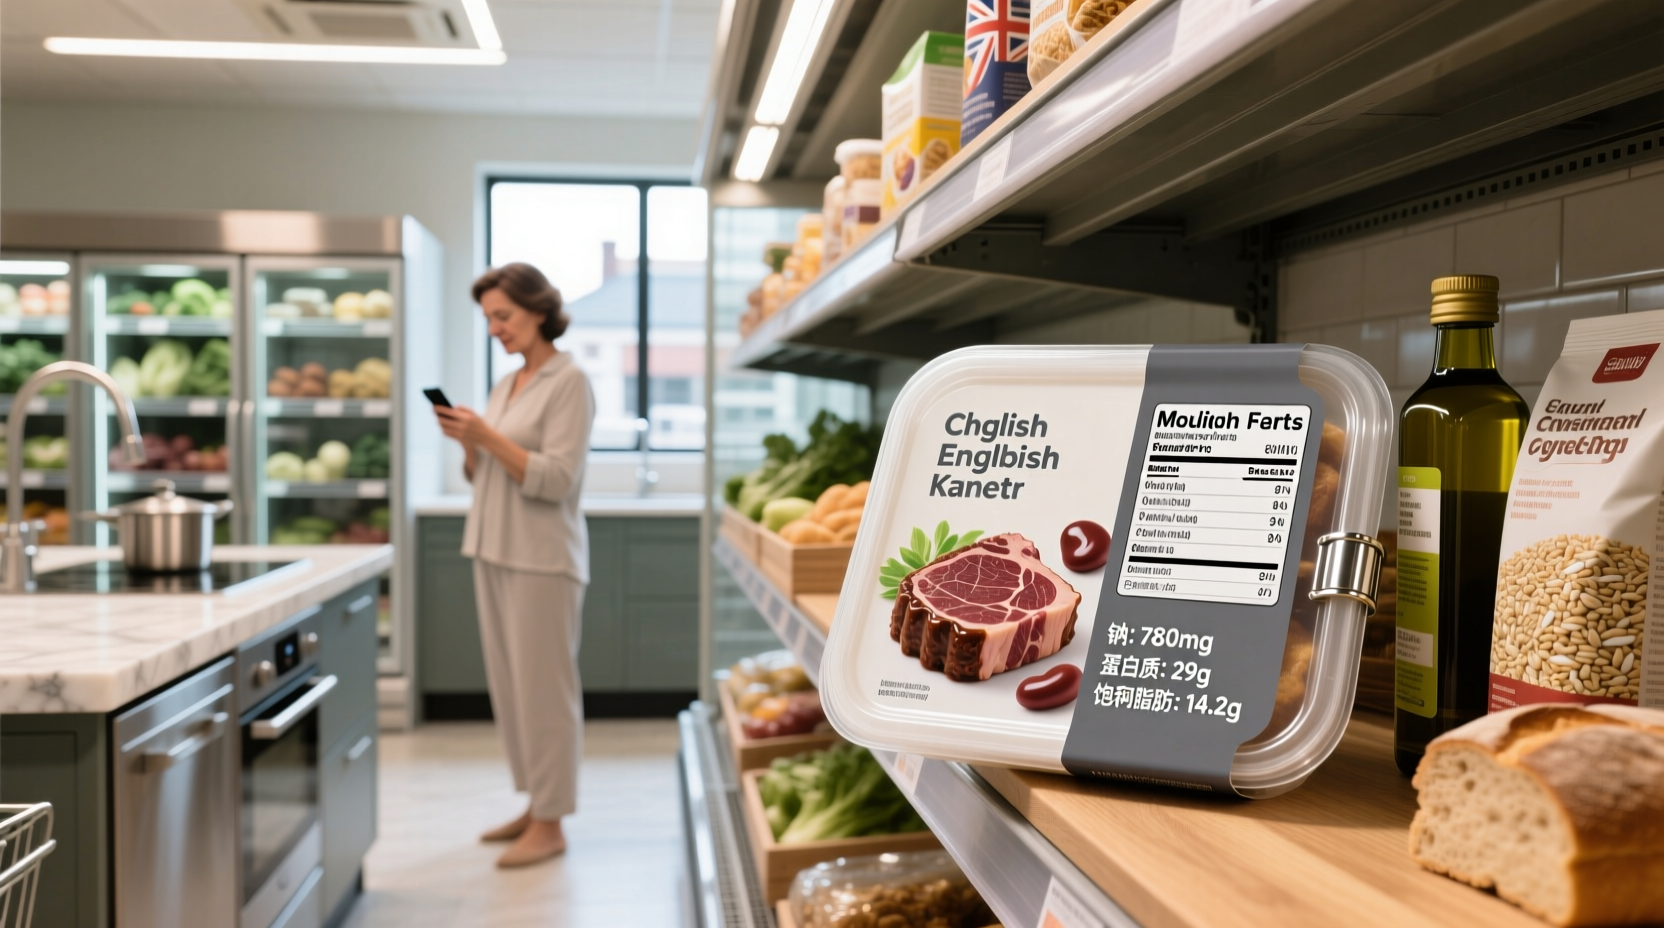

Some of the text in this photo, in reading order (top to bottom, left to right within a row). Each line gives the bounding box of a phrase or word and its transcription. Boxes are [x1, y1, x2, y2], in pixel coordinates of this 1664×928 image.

[944, 411, 1048, 443] Chglish
[1247, 411, 1304, 431] Ferts
[937, 443, 1060, 474] Englbish
[929, 473, 1025, 500] Kanetr
[1140, 626, 1214, 656] 780mg
[1171, 660, 1212, 688] 29g
[1186, 693, 1243, 723] 14.2g
